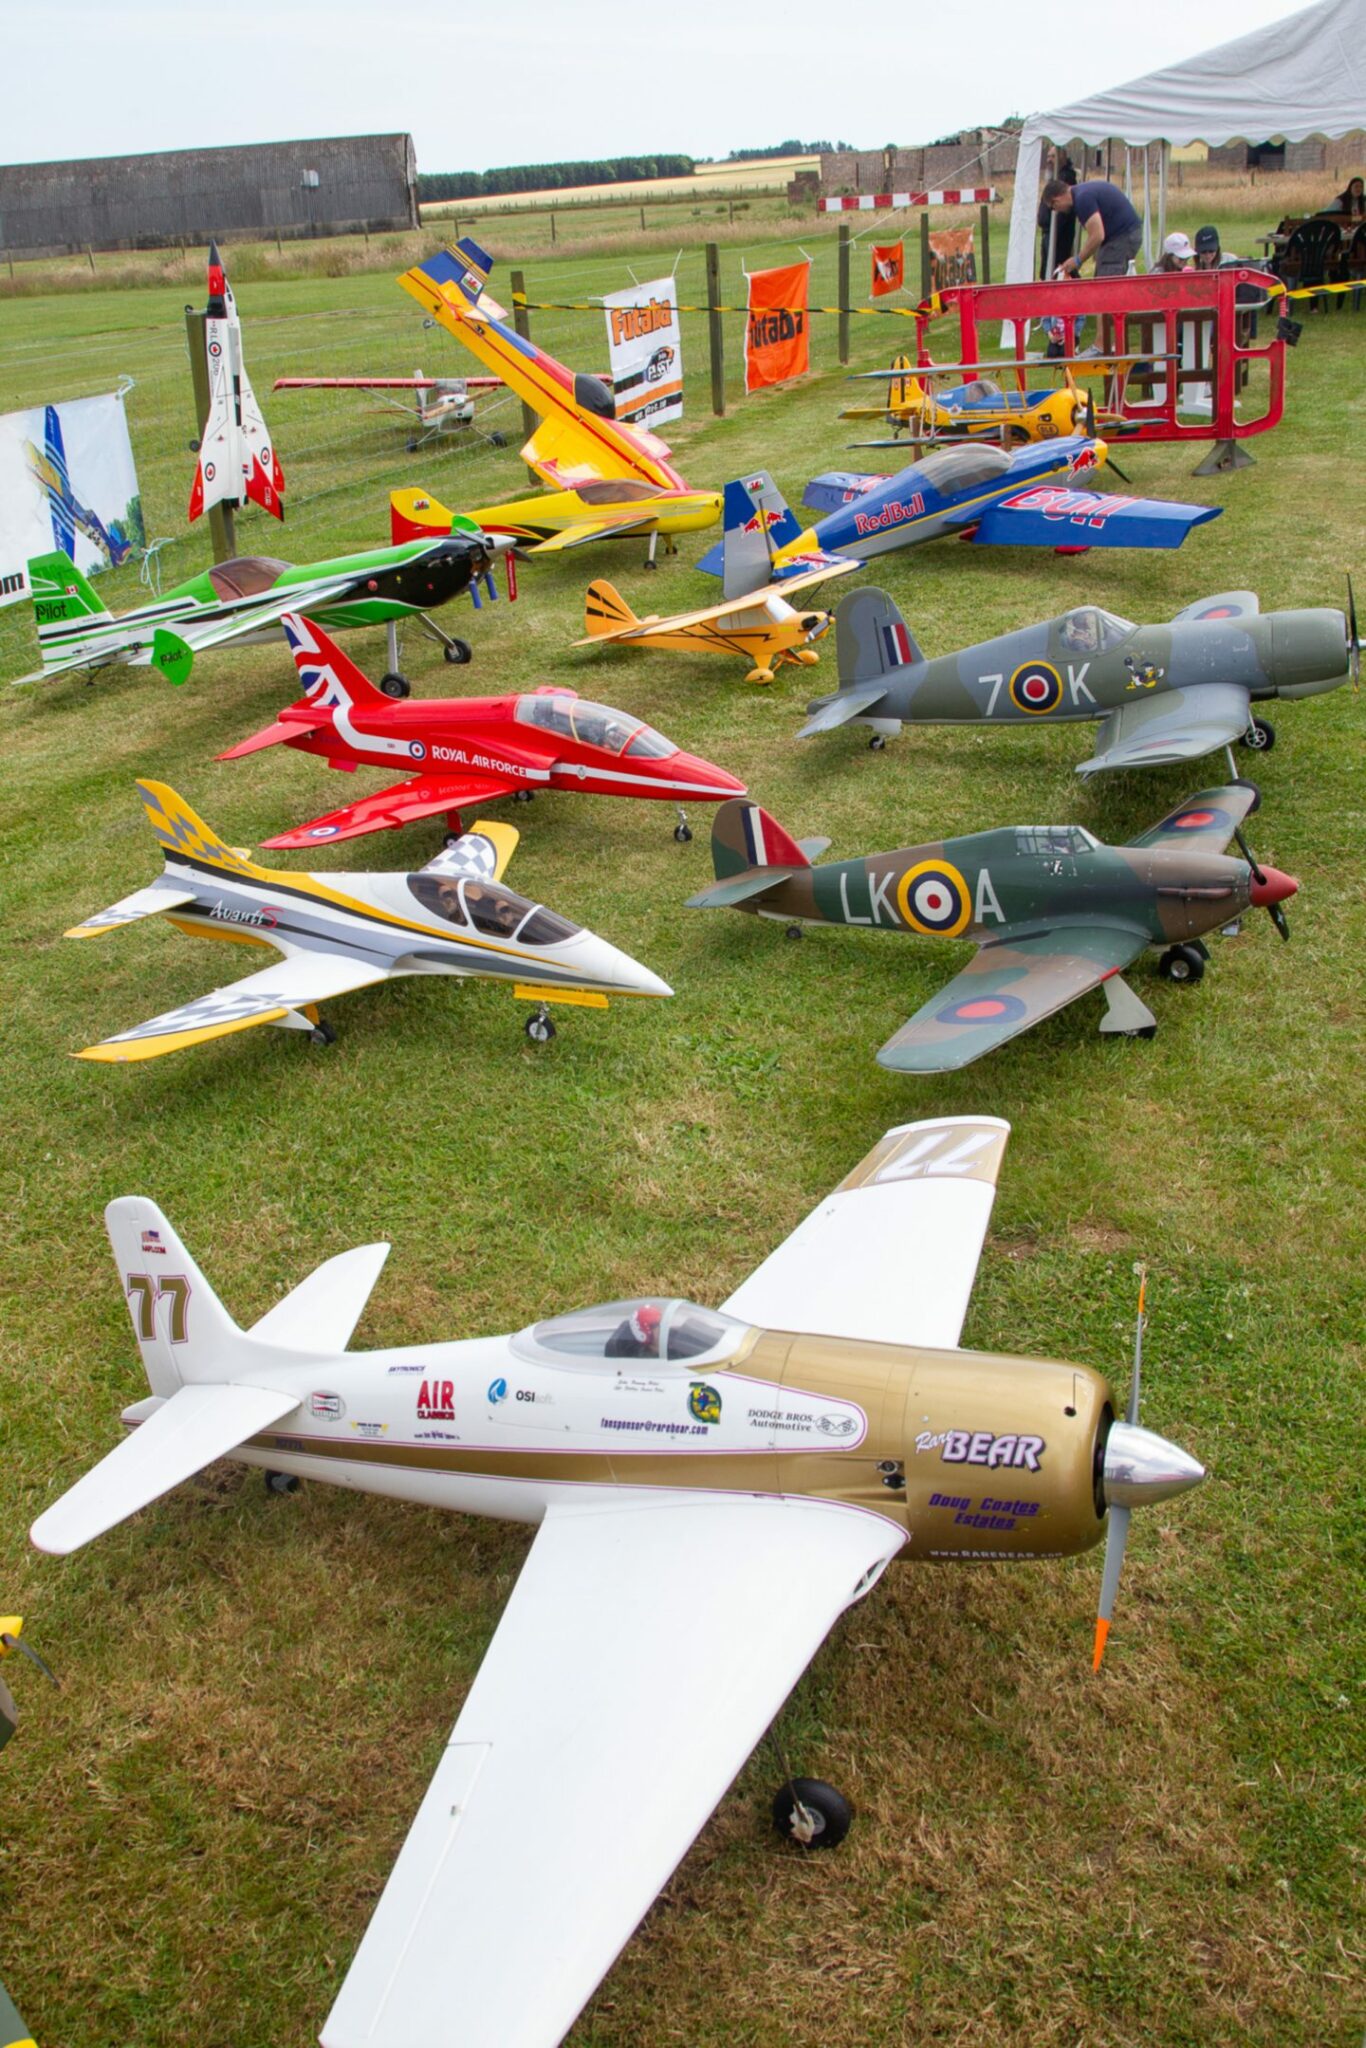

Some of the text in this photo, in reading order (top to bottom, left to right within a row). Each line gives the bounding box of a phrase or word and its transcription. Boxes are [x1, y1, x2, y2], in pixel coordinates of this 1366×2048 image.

[611, 297, 672, 346] Futaba
[997, 485, 1141, 529] Bull
[0, 571, 25, 597] m
[35, 602, 67, 621] Pilot
[160, 648, 184, 666] Pilot
[978, 662, 1097, 716] 7 K
[431, 745, 527, 778] ROYAL AIR FORCE
[839, 868, 1006, 924] LK A
[210, 899, 264, 926] Avanti
[127, 1272, 192, 1345] 77
[417, 1379, 455, 1410] AIR
[417, 1410, 455, 1421] CLASSICS
[600, 1417, 709, 1435] fansponsor@rarebear.com
[748, 1409, 784, 1420] DODGE
[749, 1418, 812, 1432] Automotive
[915, 1430, 1046, 1473] Rare BEAR
[928, 1493, 1041, 1517] Doug Coates
[954, 1512, 1017, 1531] Estates
